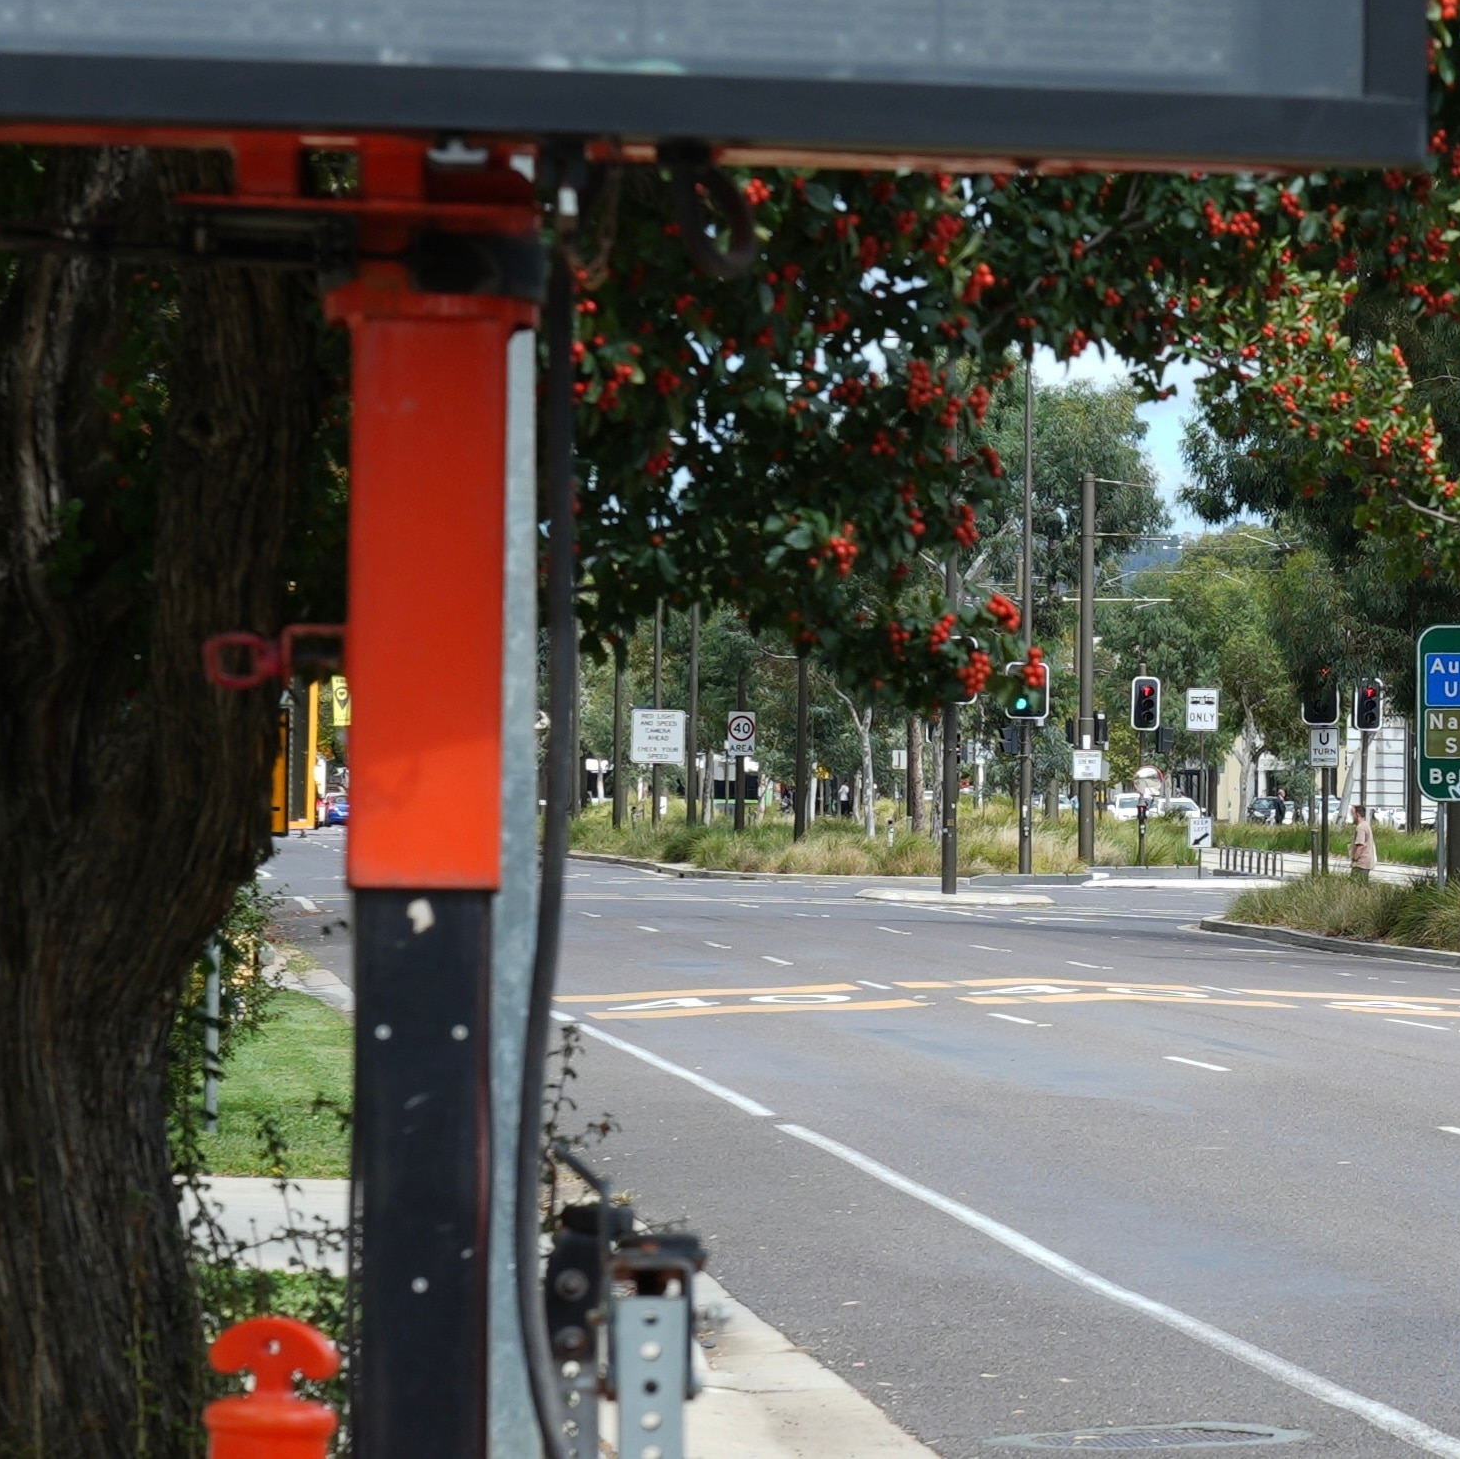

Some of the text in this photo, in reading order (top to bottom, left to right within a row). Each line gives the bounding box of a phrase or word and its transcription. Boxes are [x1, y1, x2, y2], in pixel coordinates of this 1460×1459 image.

[1189, 712, 1215, 723] ONLY
[733, 722, 751, 734] 40
[1319, 732, 1329, 745] U
[729, 744, 754, 753] AREA
[1313, 748, 1337, 756] TURN
